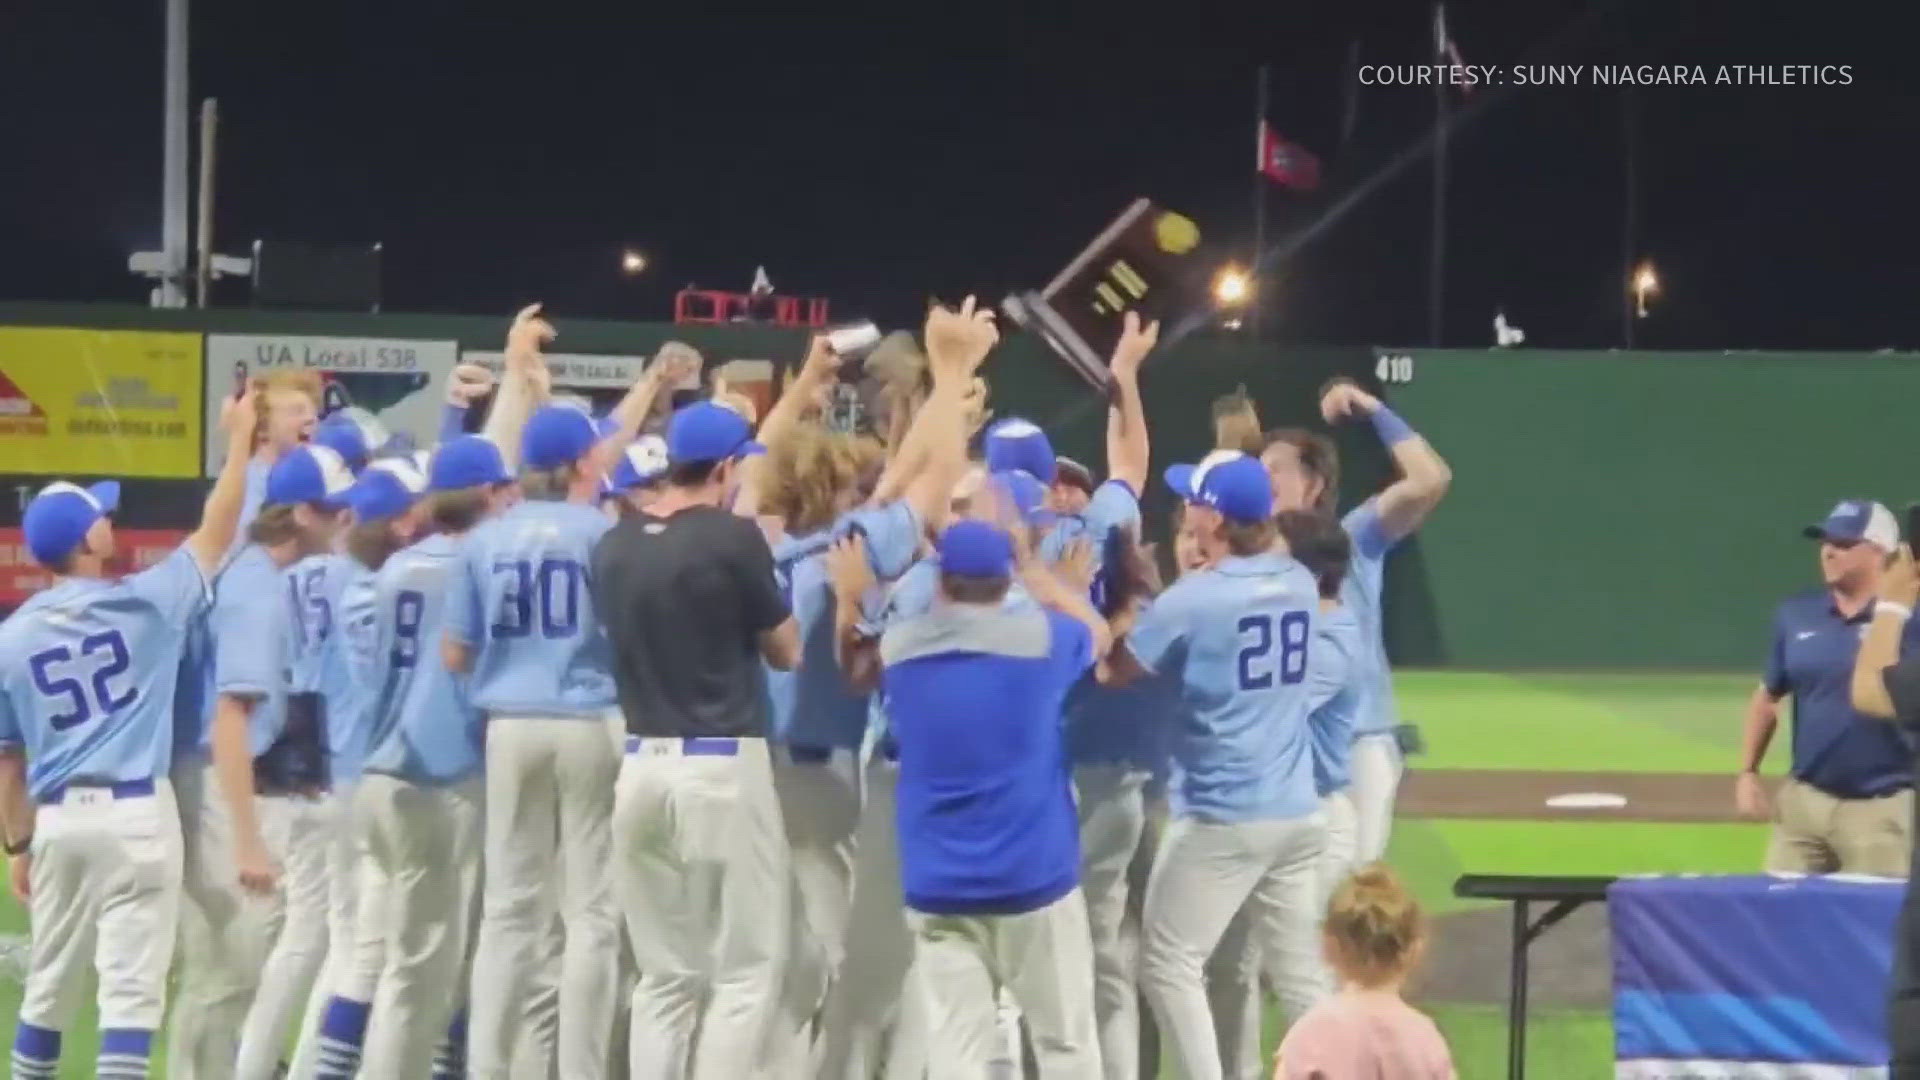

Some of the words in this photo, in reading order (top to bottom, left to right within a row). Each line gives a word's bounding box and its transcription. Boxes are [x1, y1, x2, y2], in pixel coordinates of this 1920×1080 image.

[256, 344, 293, 365] UA
[304, 344, 367, 368] Local
[376, 347, 417, 369] 538
[1375, 355, 1413, 382] 410
[491, 557, 578, 640] 30
[29, 629, 139, 732] 52
[1238, 610, 1310, 691] 28
